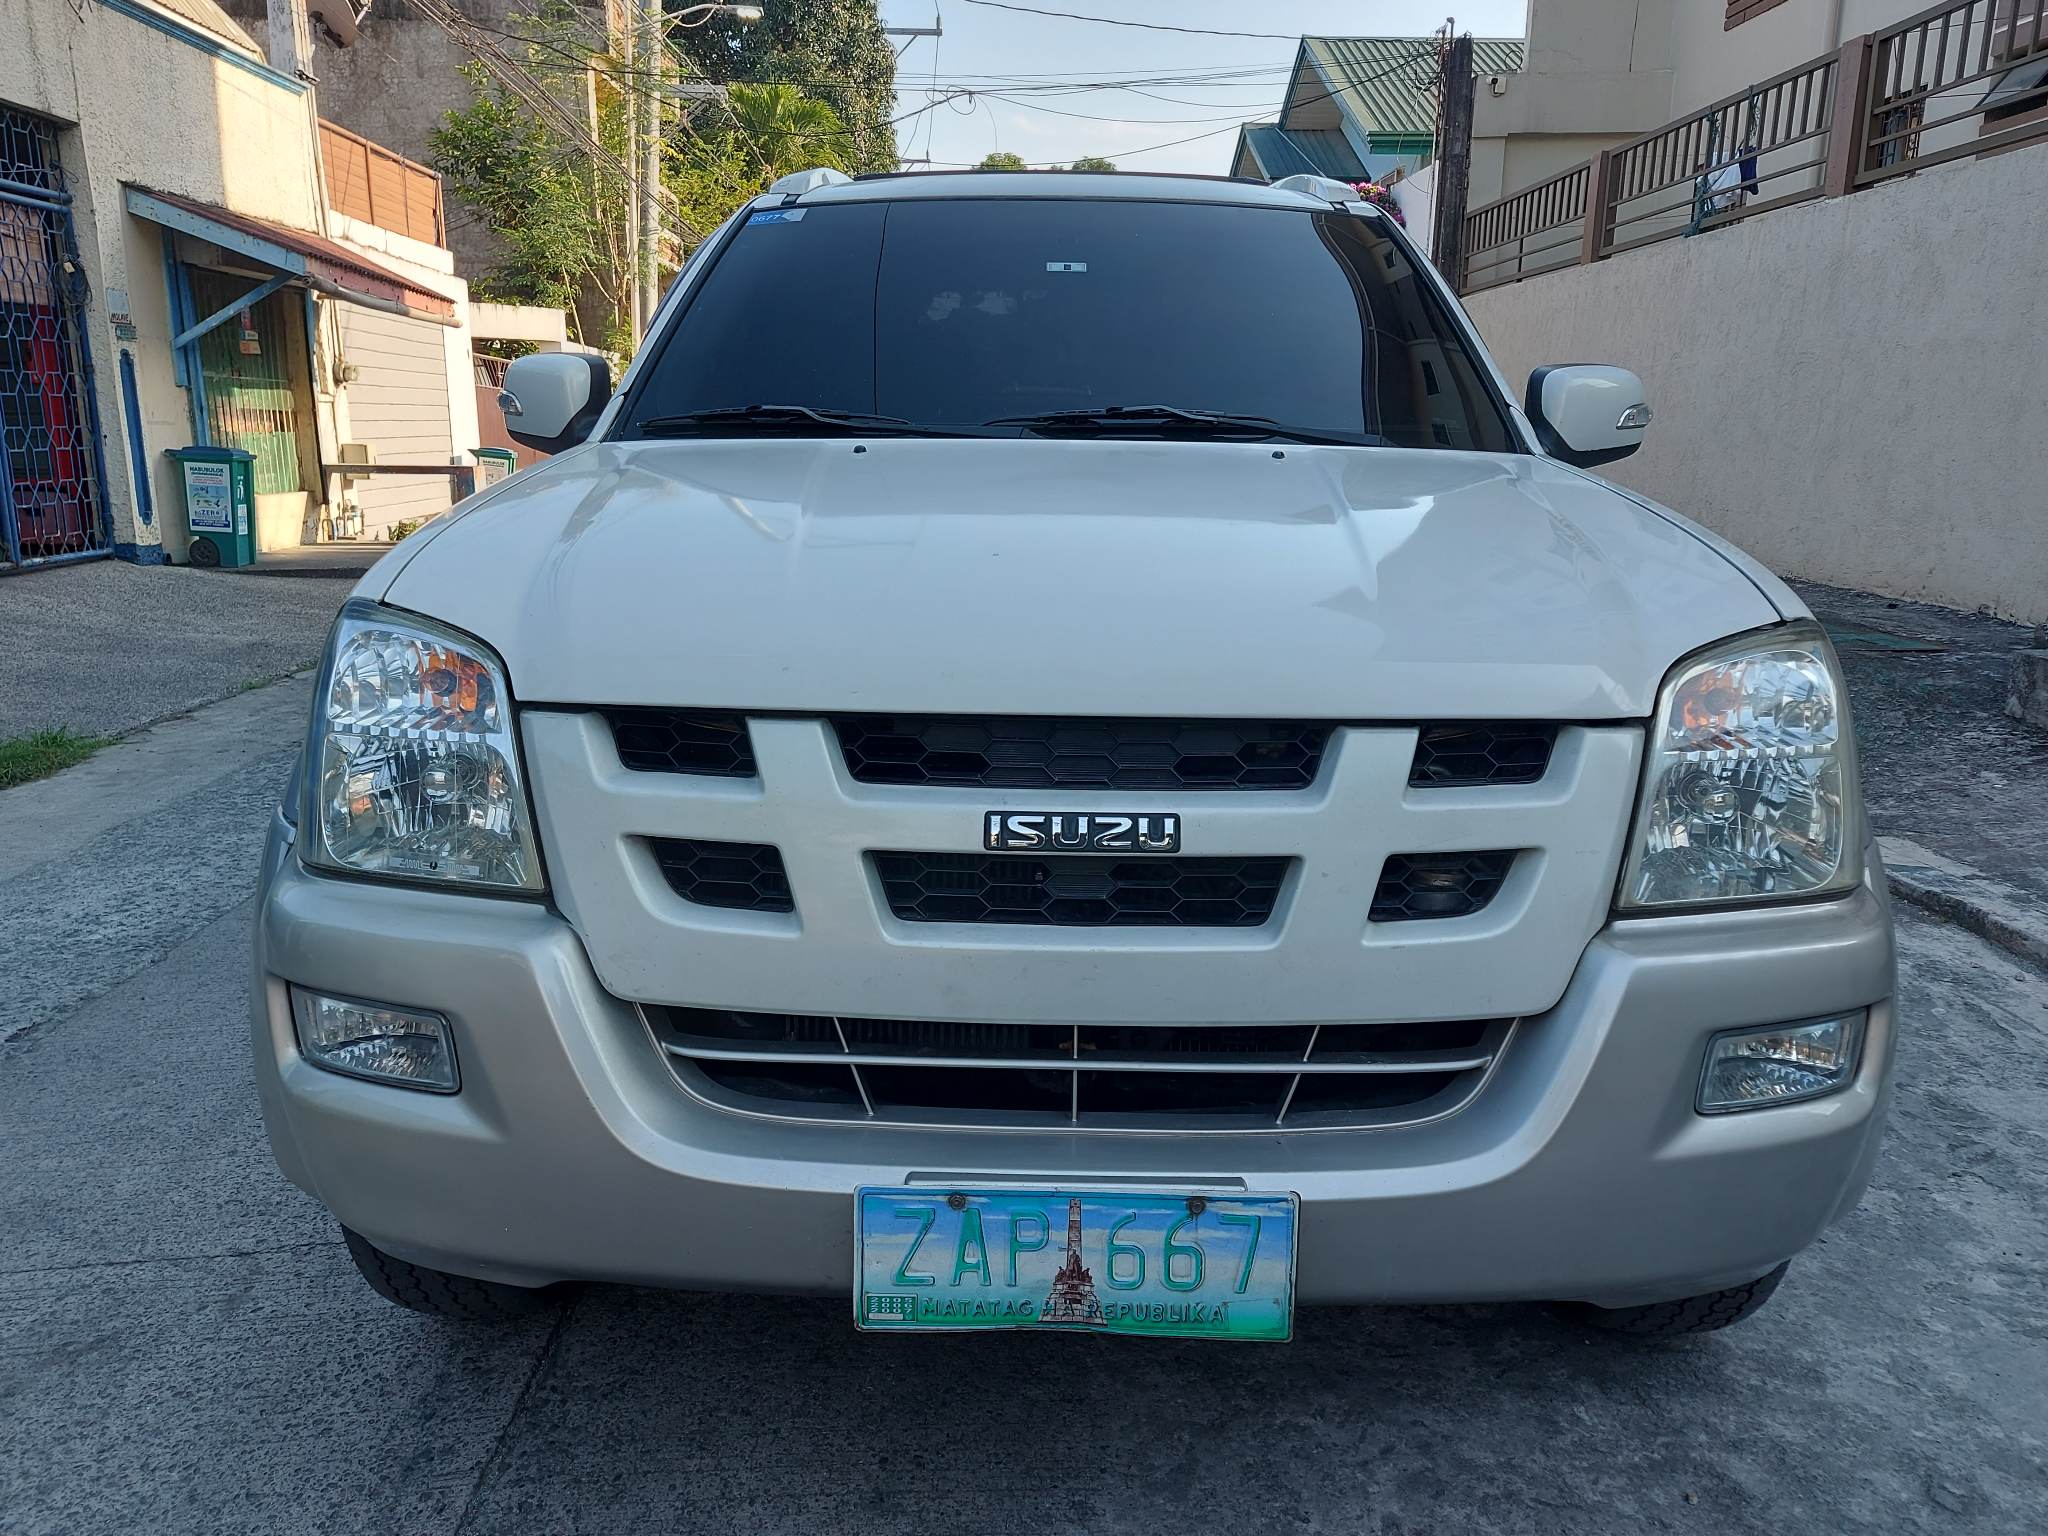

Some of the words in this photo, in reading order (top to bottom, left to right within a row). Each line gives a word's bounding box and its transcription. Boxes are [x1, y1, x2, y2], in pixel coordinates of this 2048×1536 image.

[989, 815, 1176, 849] ISUZU
[893, 1207, 1050, 1288] ZAP
[1106, 1211, 1262, 1294] 667
[923, 1298, 1034, 1317] MATATAG
[1087, 1301, 1226, 1324] REPUBLIKA
